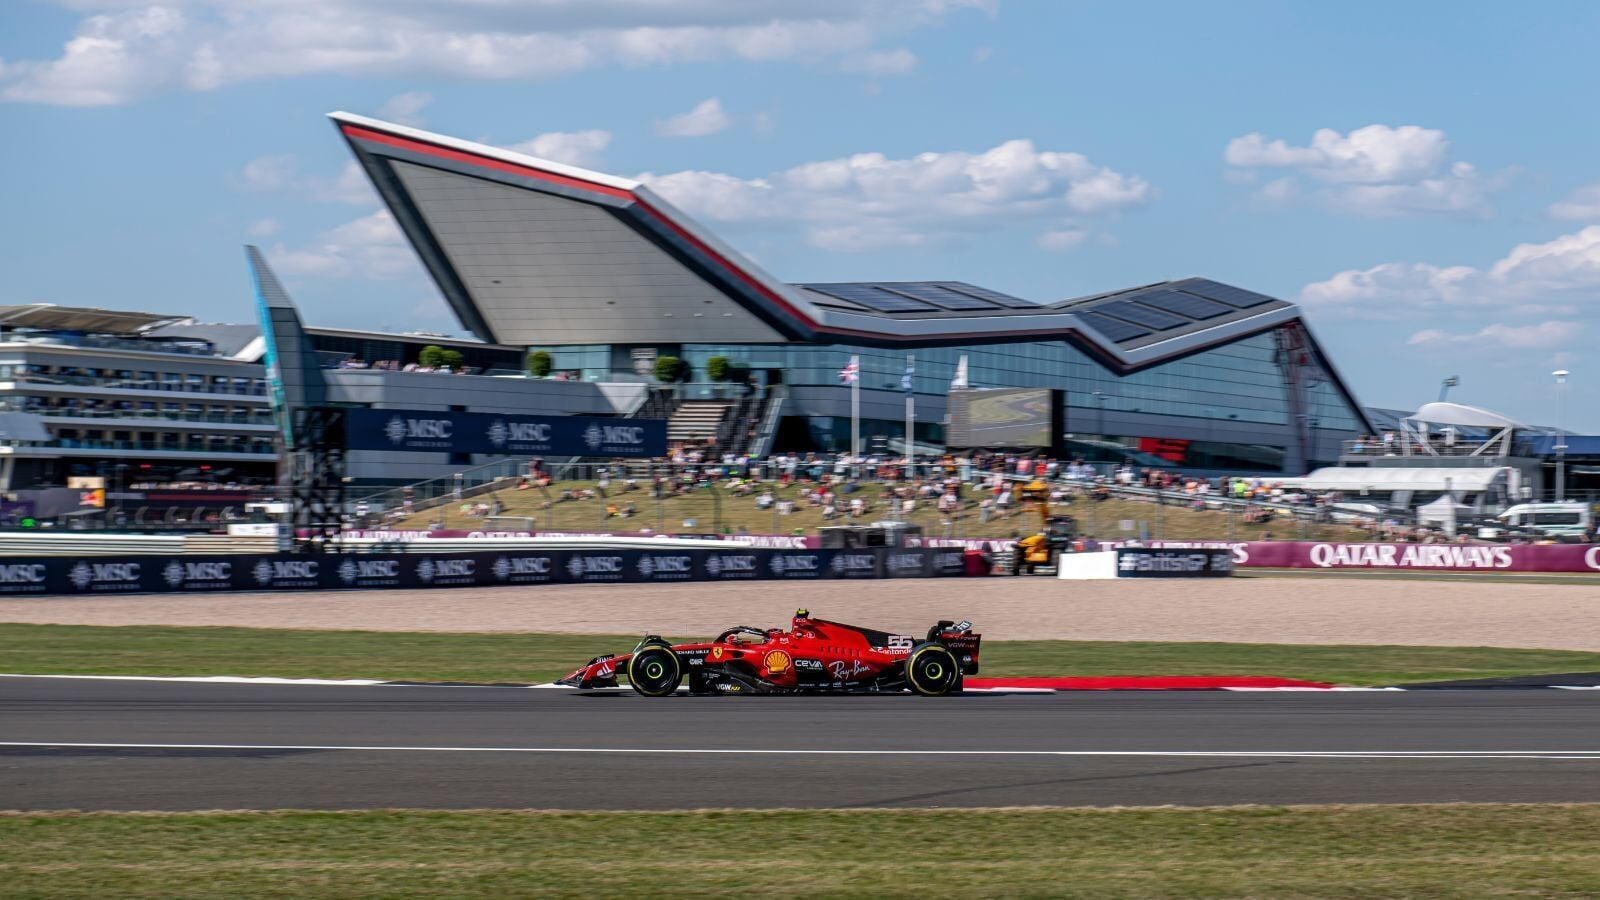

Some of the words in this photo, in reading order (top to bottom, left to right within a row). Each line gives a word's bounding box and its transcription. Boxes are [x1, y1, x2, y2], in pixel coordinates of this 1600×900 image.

[406, 419, 453, 438] MSC
[508, 422, 551, 441] MSC
[603, 426, 644, 444] MSC
[583, 556, 623, 572] MSC
[654, 556, 691, 571] MSC
[720, 555, 756, 570] MSC
[785, 555, 818, 570] MSC
[1310, 544, 1397, 567] QATAR
[1399, 546, 1513, 567] AIRWAYS
[93, 563, 140, 581] MSC
[184, 562, 231, 580] MSC
[273, 561, 319, 578] MSC
[358, 560, 400, 577] MSC
[435, 559, 476, 576] MSC
[511, 557, 551, 573] MSC
[887, 635, 913, 649] 55
[828, 659, 870, 680] Ray-Ban
